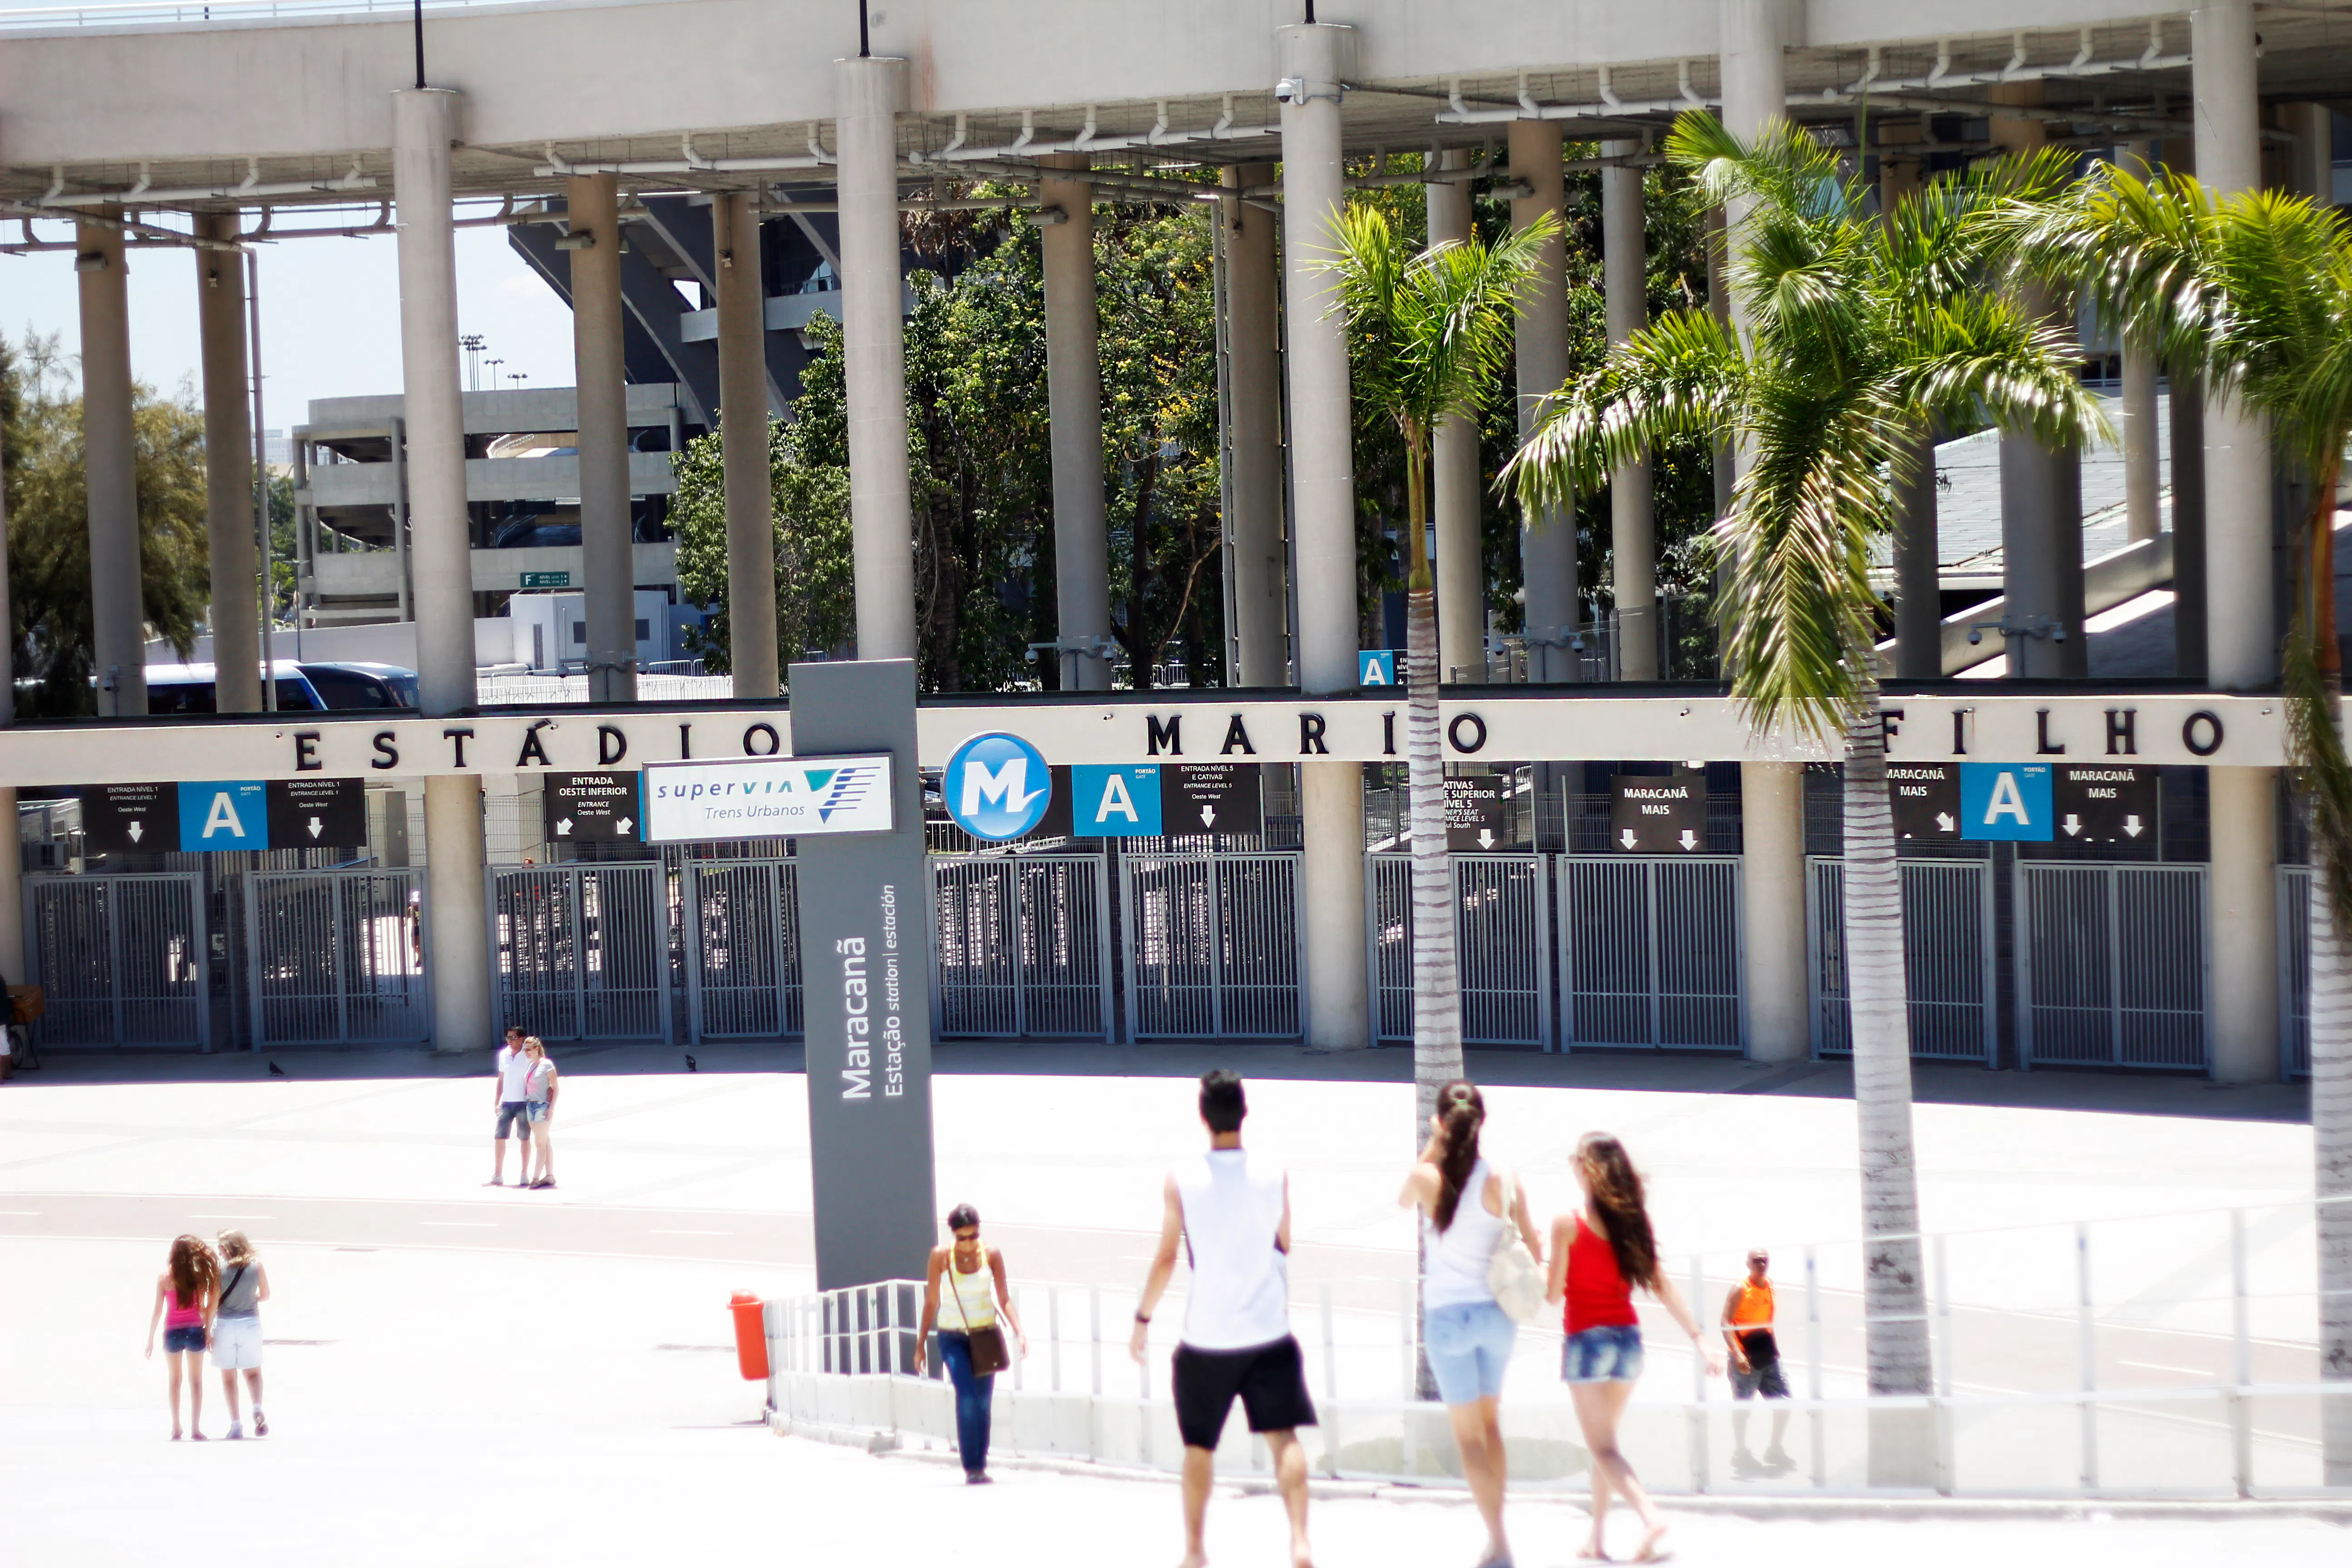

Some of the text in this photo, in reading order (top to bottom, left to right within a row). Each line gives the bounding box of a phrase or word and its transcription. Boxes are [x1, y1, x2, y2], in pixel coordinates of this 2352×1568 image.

[525, 575, 531, 585] F
[1363, 658, 1386, 685] A
[1145, 711, 1487, 755] MARIO
[1881, 709, 2224, 756] FILHO
[294, 719, 779, 771] ESTÁDIO
[572, 777, 613, 785] ENTRADA
[1443, 781, 1473, 789] ATIVAS
[2070, 769, 2135, 781] MARACANÃ
[559, 787, 627, 796] OESTE INFERIOR
[961, 758, 1046, 816] M
[1444, 790, 1495, 799] E SUPERIOR
[1624, 786, 1688, 799] MARACANÃ
[1900, 786, 1927, 796] MAIS
[2089, 788, 2117, 799] MAIS
[1095, 774, 1140, 822] A
[1467, 800, 1472, 808] 5
[1984, 772, 2030, 825] A
[202, 792, 245, 838] A
[705, 804, 805, 819] Trens Urbanos
[1642, 805, 1670, 815] MAIS
[882, 884, 897, 949] estación
[885, 959, 899, 1011] station
[837, 937, 871, 1099] Maracanã
[883, 1016, 906, 1097] Estação
